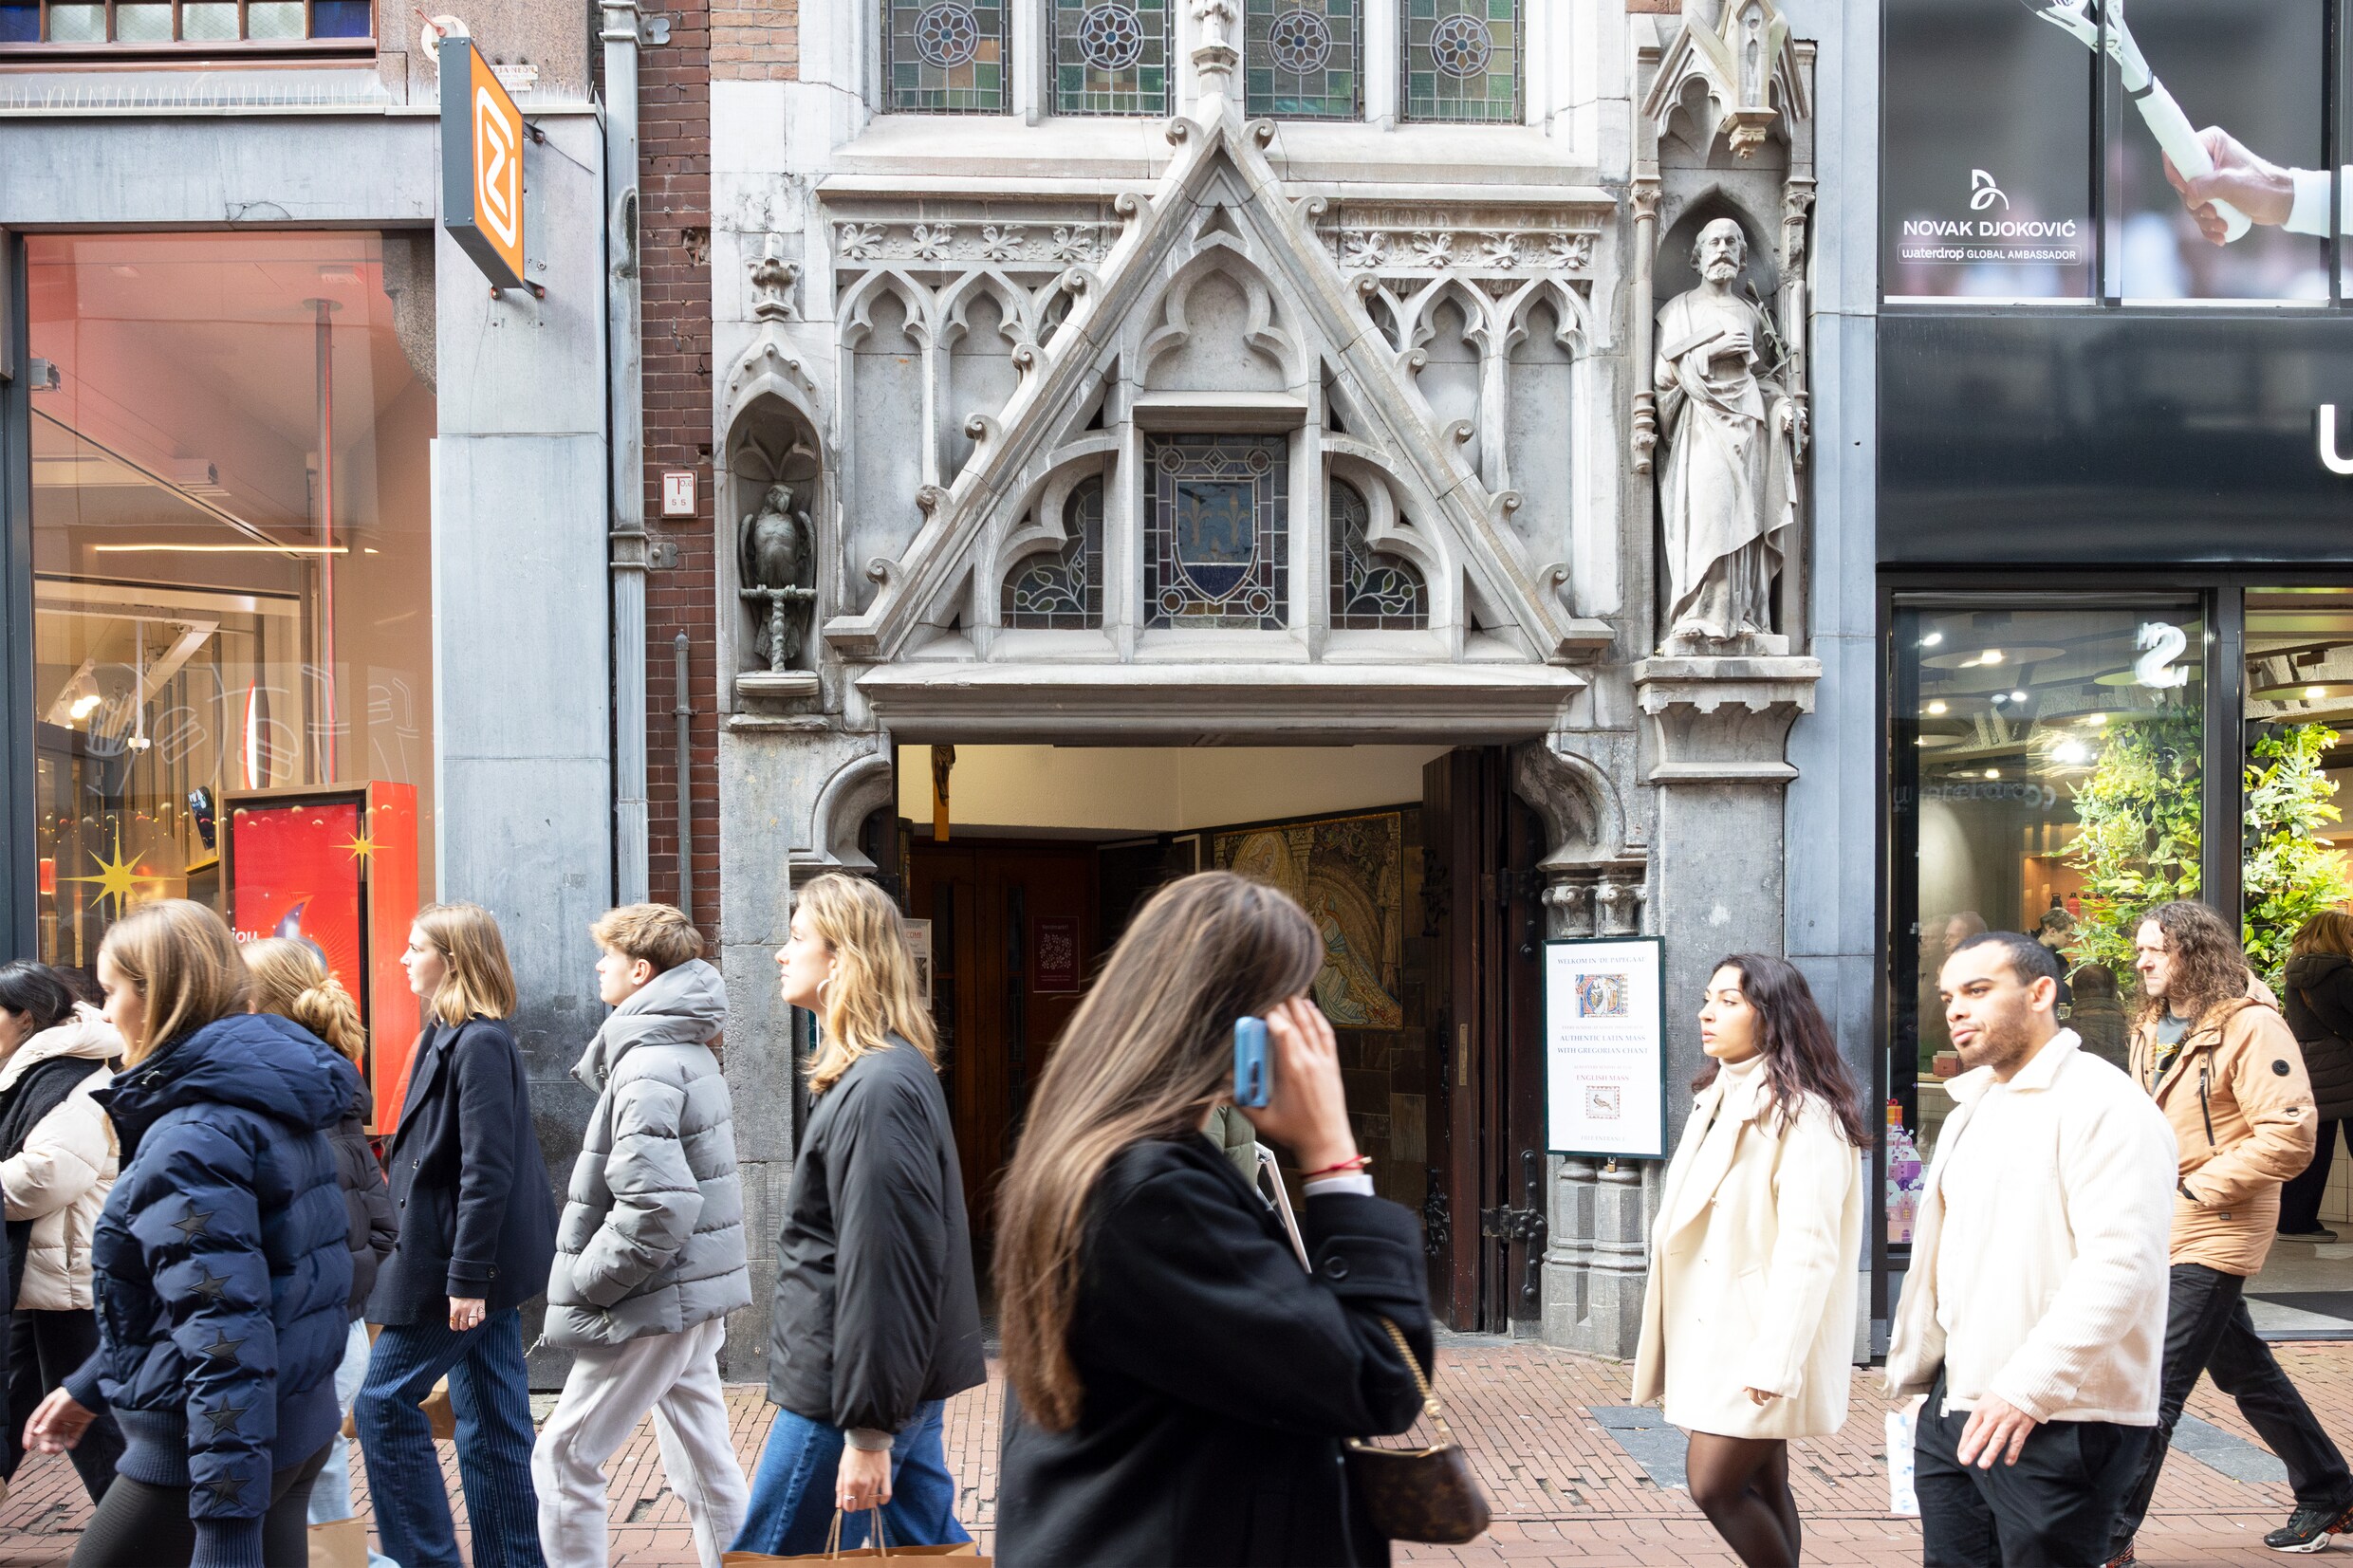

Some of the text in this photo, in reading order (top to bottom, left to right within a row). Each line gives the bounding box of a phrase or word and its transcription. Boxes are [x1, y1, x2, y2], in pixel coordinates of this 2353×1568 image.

[1903, 218, 2077, 237] NOVAK DJOKOVIĆ
[1902, 247, 2076, 261] waterdrop GLOBAL AMBASSADOR
